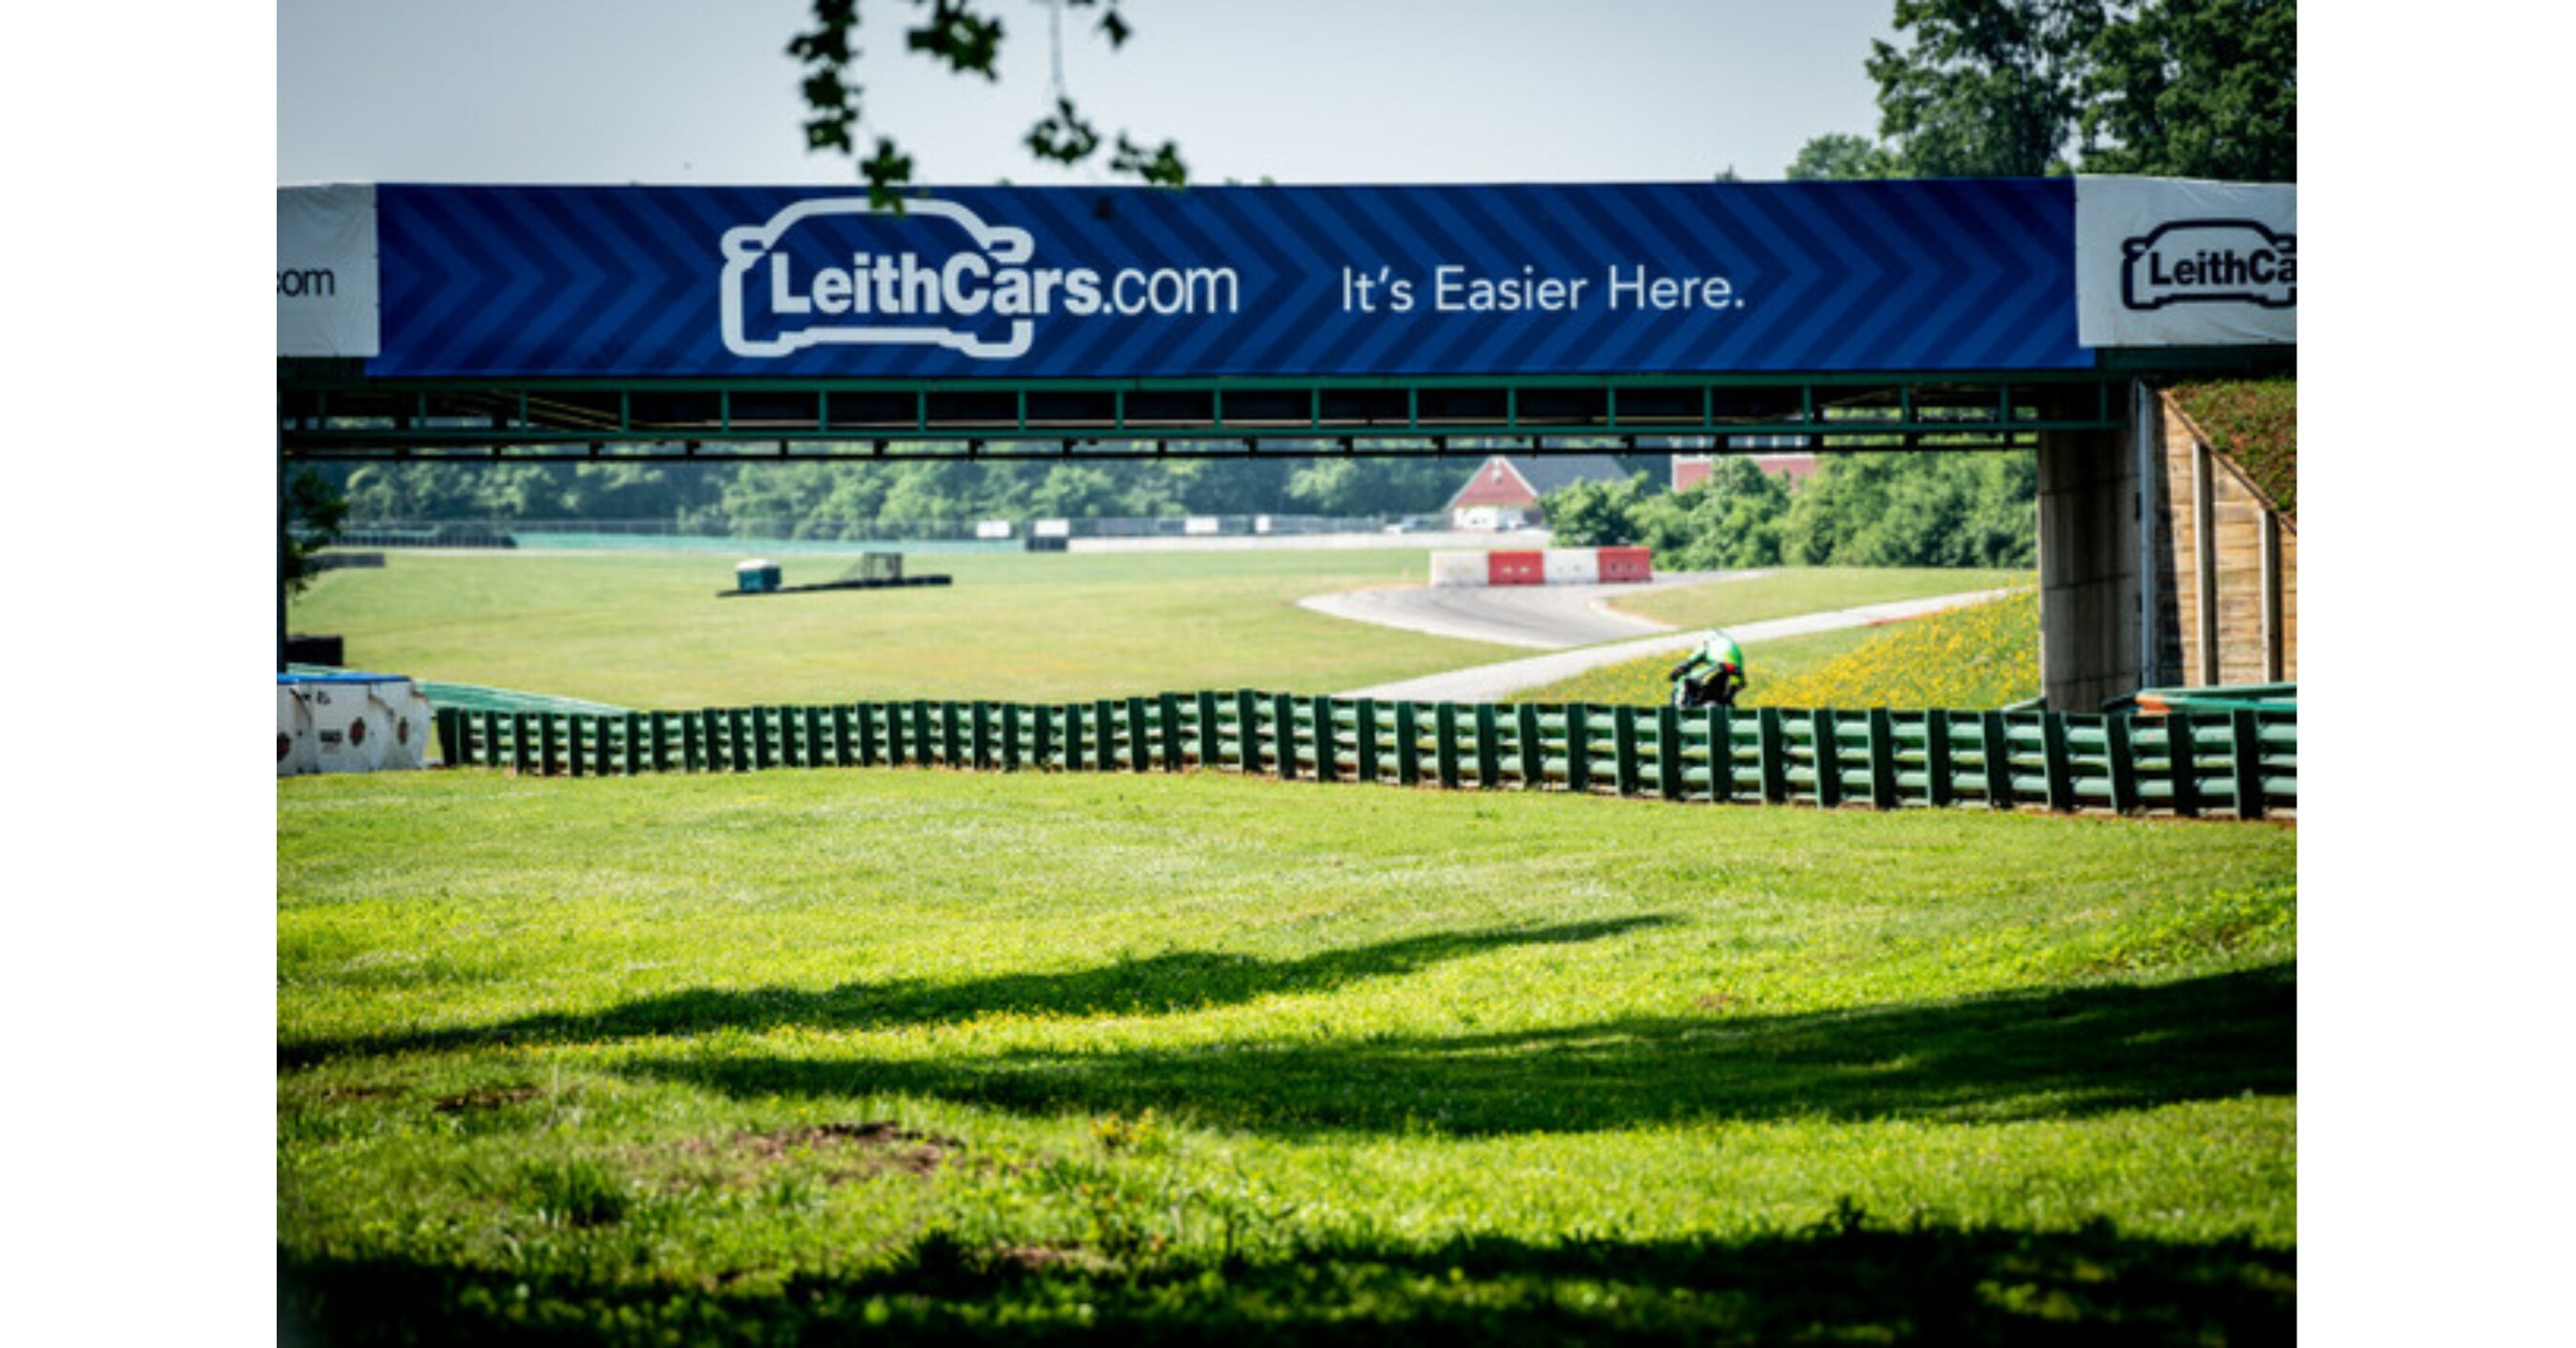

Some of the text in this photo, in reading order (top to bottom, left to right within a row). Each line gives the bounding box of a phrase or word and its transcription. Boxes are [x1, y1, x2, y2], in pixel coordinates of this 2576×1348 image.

[277, 268, 336, 298] om
[771, 252, 1238, 315] LeithCars.com
[1342, 264, 1745, 312] It’s Easier Here.
[2150, 249, 2297, 285] LeithCa
